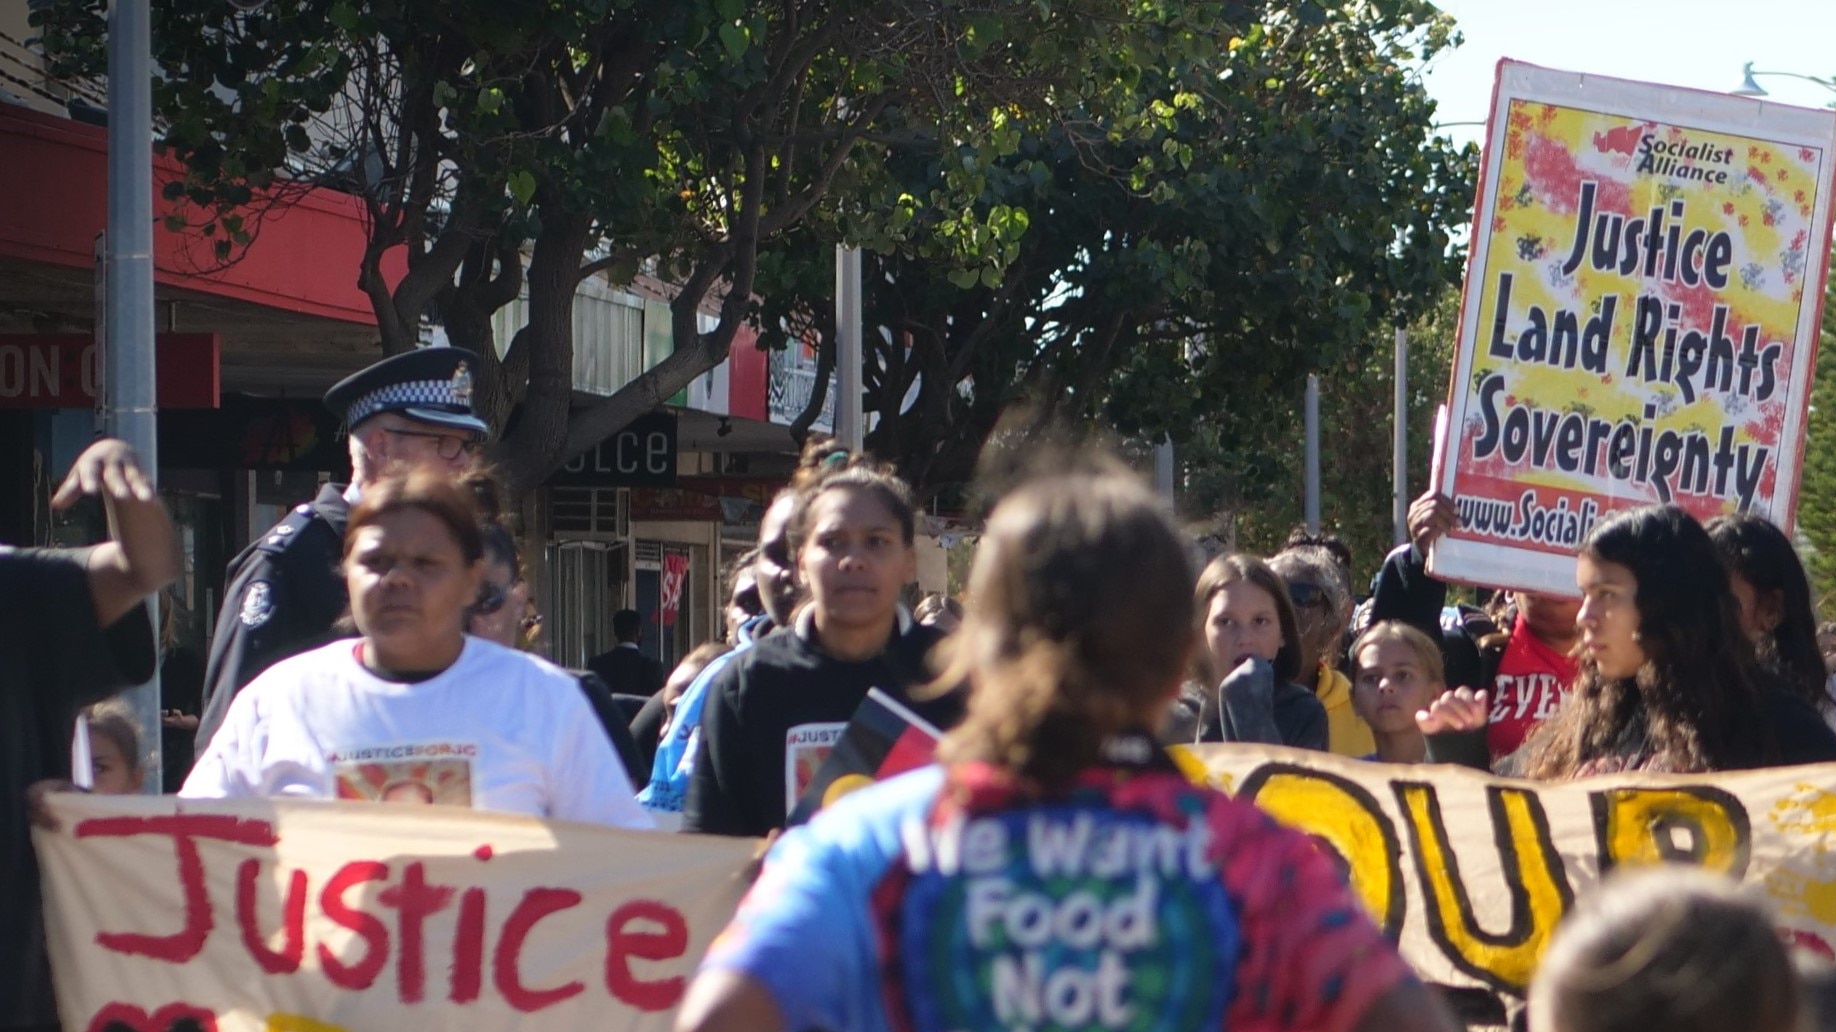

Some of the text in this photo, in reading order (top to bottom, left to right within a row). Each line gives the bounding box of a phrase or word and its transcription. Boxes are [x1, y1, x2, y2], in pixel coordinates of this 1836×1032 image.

[1636, 153, 1728, 185] Alliance
[1638, 134, 1734, 165] Socialist
[1563, 182, 1731, 288] Justice
[1490, 274, 1780, 403] Land Rights
[1474, 376, 1768, 512] Sovereignty
[1457, 490, 1599, 546] www.Sociali
[1028, 811, 1217, 877] Want
[74, 814, 690, 1012] Justice
[964, 876, 1162, 950] Food
[990, 952, 1134, 1030] Not
